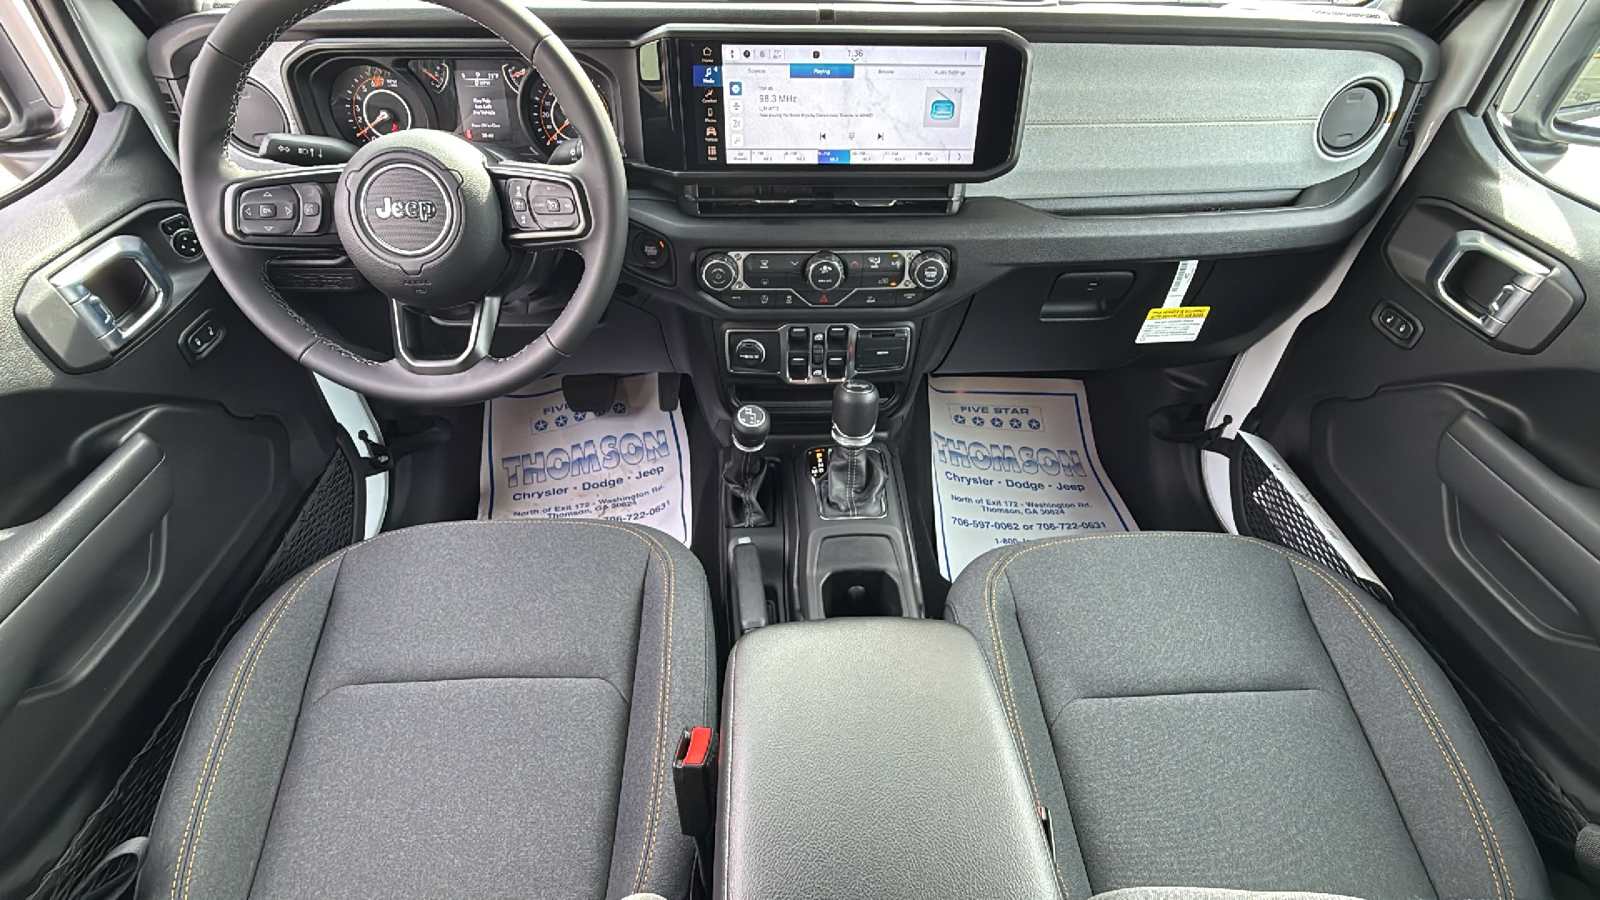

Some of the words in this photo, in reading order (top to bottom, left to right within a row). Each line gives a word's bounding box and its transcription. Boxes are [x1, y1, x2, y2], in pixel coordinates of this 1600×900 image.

[847, 49, 864, 58] 1:36
[813, 68, 831, 76] Playing
[778, 94, 798, 103] MHz
[375, 196, 437, 223] Jeep
[960, 406, 989, 414] FIVE
[994, 407, 1029, 415] STAR
[501, 429, 671, 489] THOMSON
[933, 431, 1087, 478] THOMSON
[512, 486, 569, 501] Chrysler
[581, 477, 624, 491] Dodge
[635, 465, 664, 480] Jeep
[945, 471, 994, 486] Chrysler
[1005, 479, 1045, 491] Dodge
[1056, 482, 1086, 492] Jeep
[513, 508, 539, 517] North
[554, 504, 572, 512] Exit
[575, 501, 590, 509] 172
[598, 490, 650, 505] Washington
[594, 503, 609, 512] GA
[951, 494, 973, 504] North
[1025, 501, 1075, 509] Washington
